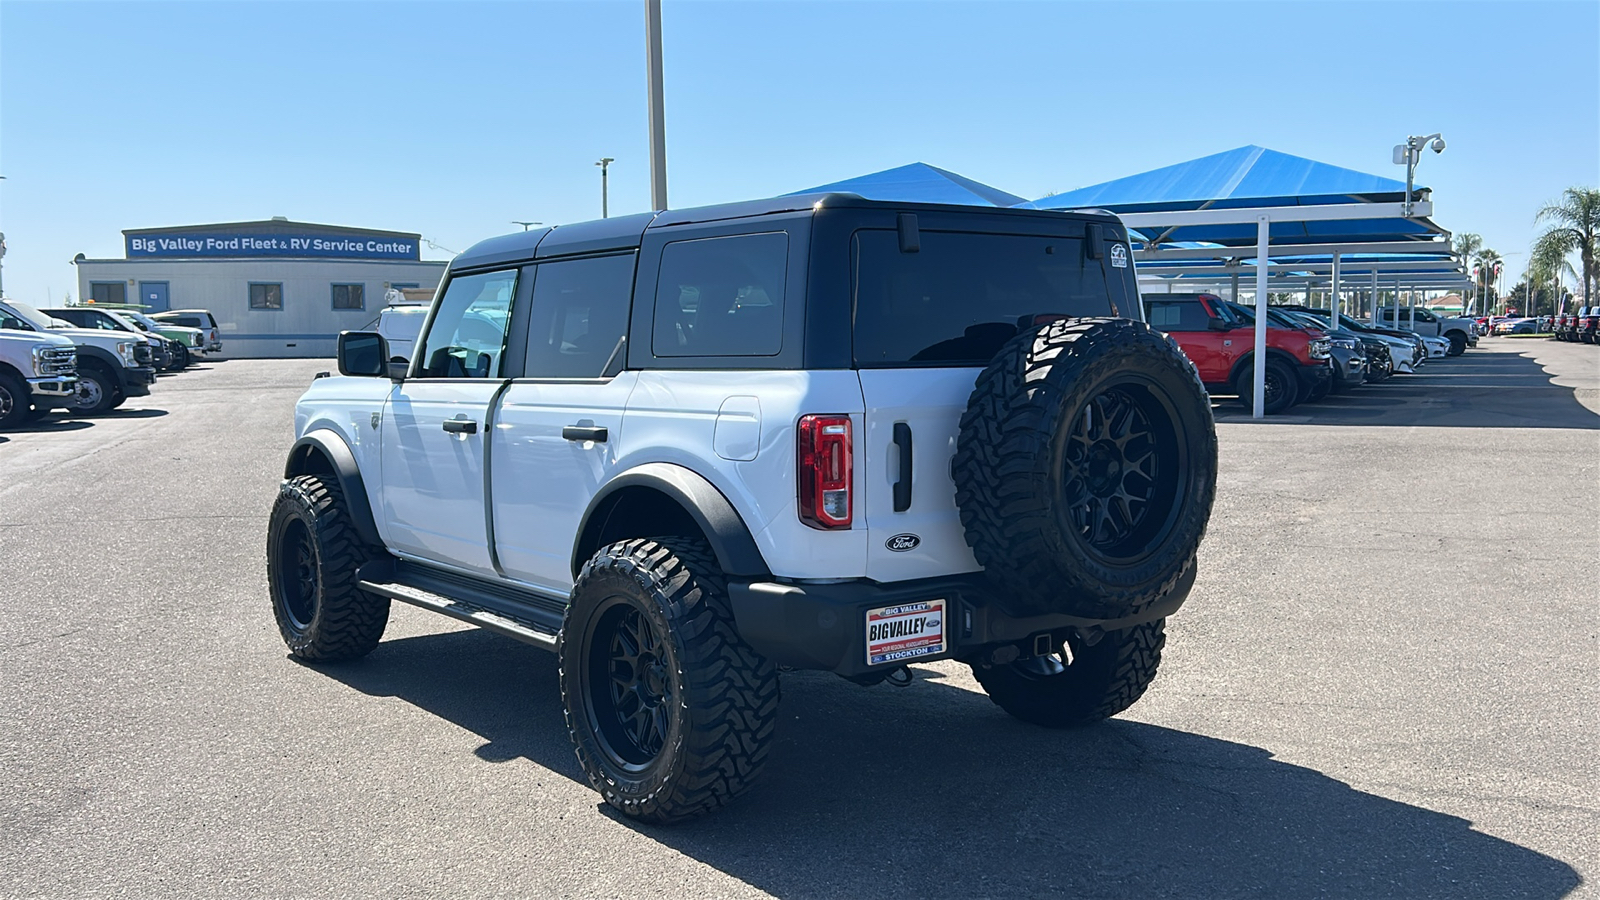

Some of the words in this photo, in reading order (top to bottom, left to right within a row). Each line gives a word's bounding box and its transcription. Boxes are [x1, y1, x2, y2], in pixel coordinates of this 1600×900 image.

[132, 238, 156, 252] Big
[159, 238, 204, 252] Valley
[206, 237, 238, 250] Ford
[242, 237, 278, 250] Fleet
[280, 242, 288, 250] &
[290, 238, 310, 250] RV
[313, 239, 364, 252] Service
[366, 240, 412, 254] Center
[892, 536, 916, 549] Ford
[885, 607, 899, 615] BIG
[900, 603, 927, 613] VALLEY
[870, 617, 927, 641] BIGVALLEY
[885, 648, 928, 660] STOCKTON
